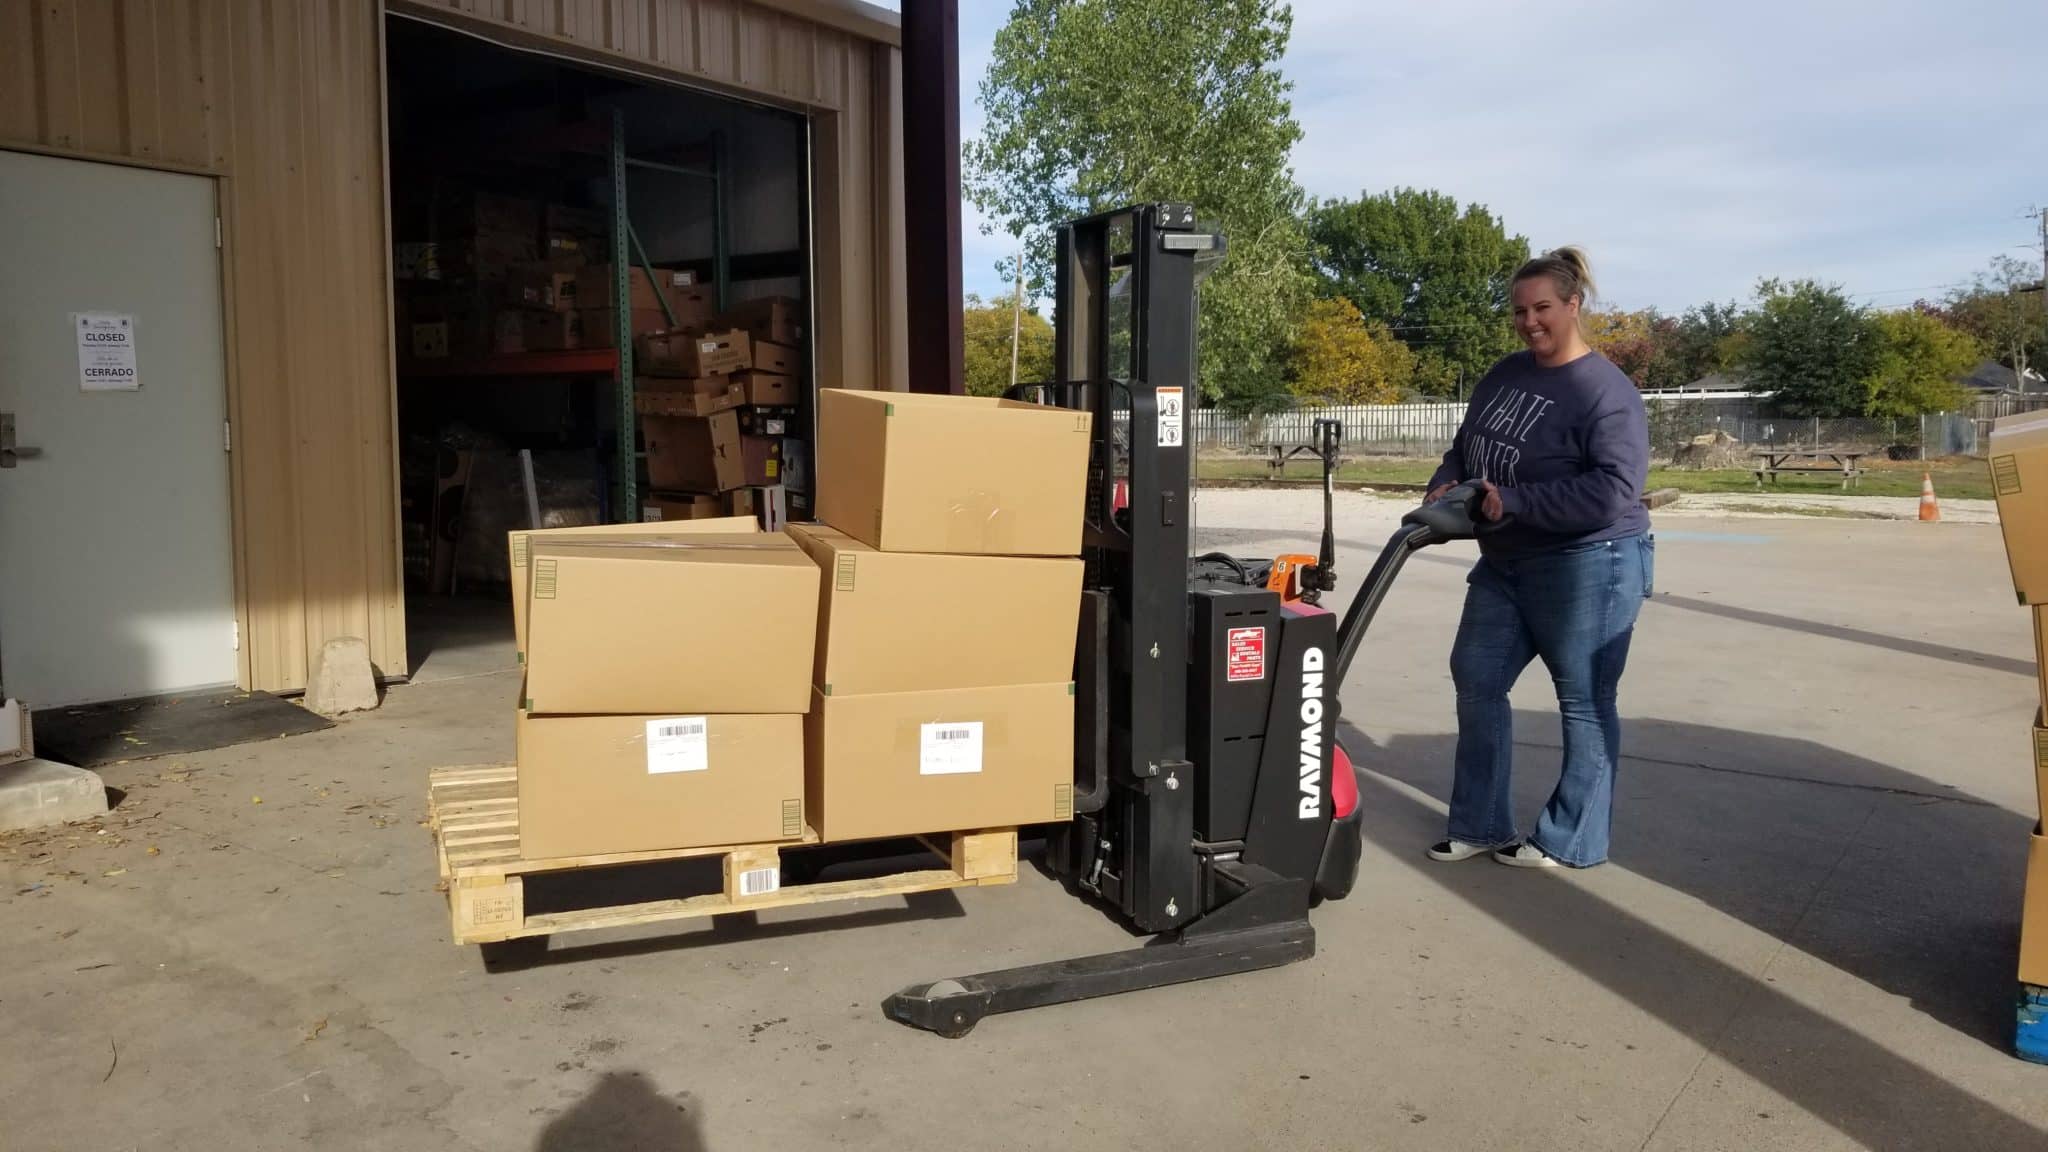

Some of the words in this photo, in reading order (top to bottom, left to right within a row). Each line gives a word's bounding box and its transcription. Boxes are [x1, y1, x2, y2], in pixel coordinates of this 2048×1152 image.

[86, 333, 126, 342] CLOSED
[85, 368, 134, 377] CERRADO
[1475, 384, 1505, 425] I
[1484, 388, 1555, 443] HATE
[1463, 432, 1520, 489] WINTER
[1298, 646, 1324, 819] RAYMOND
